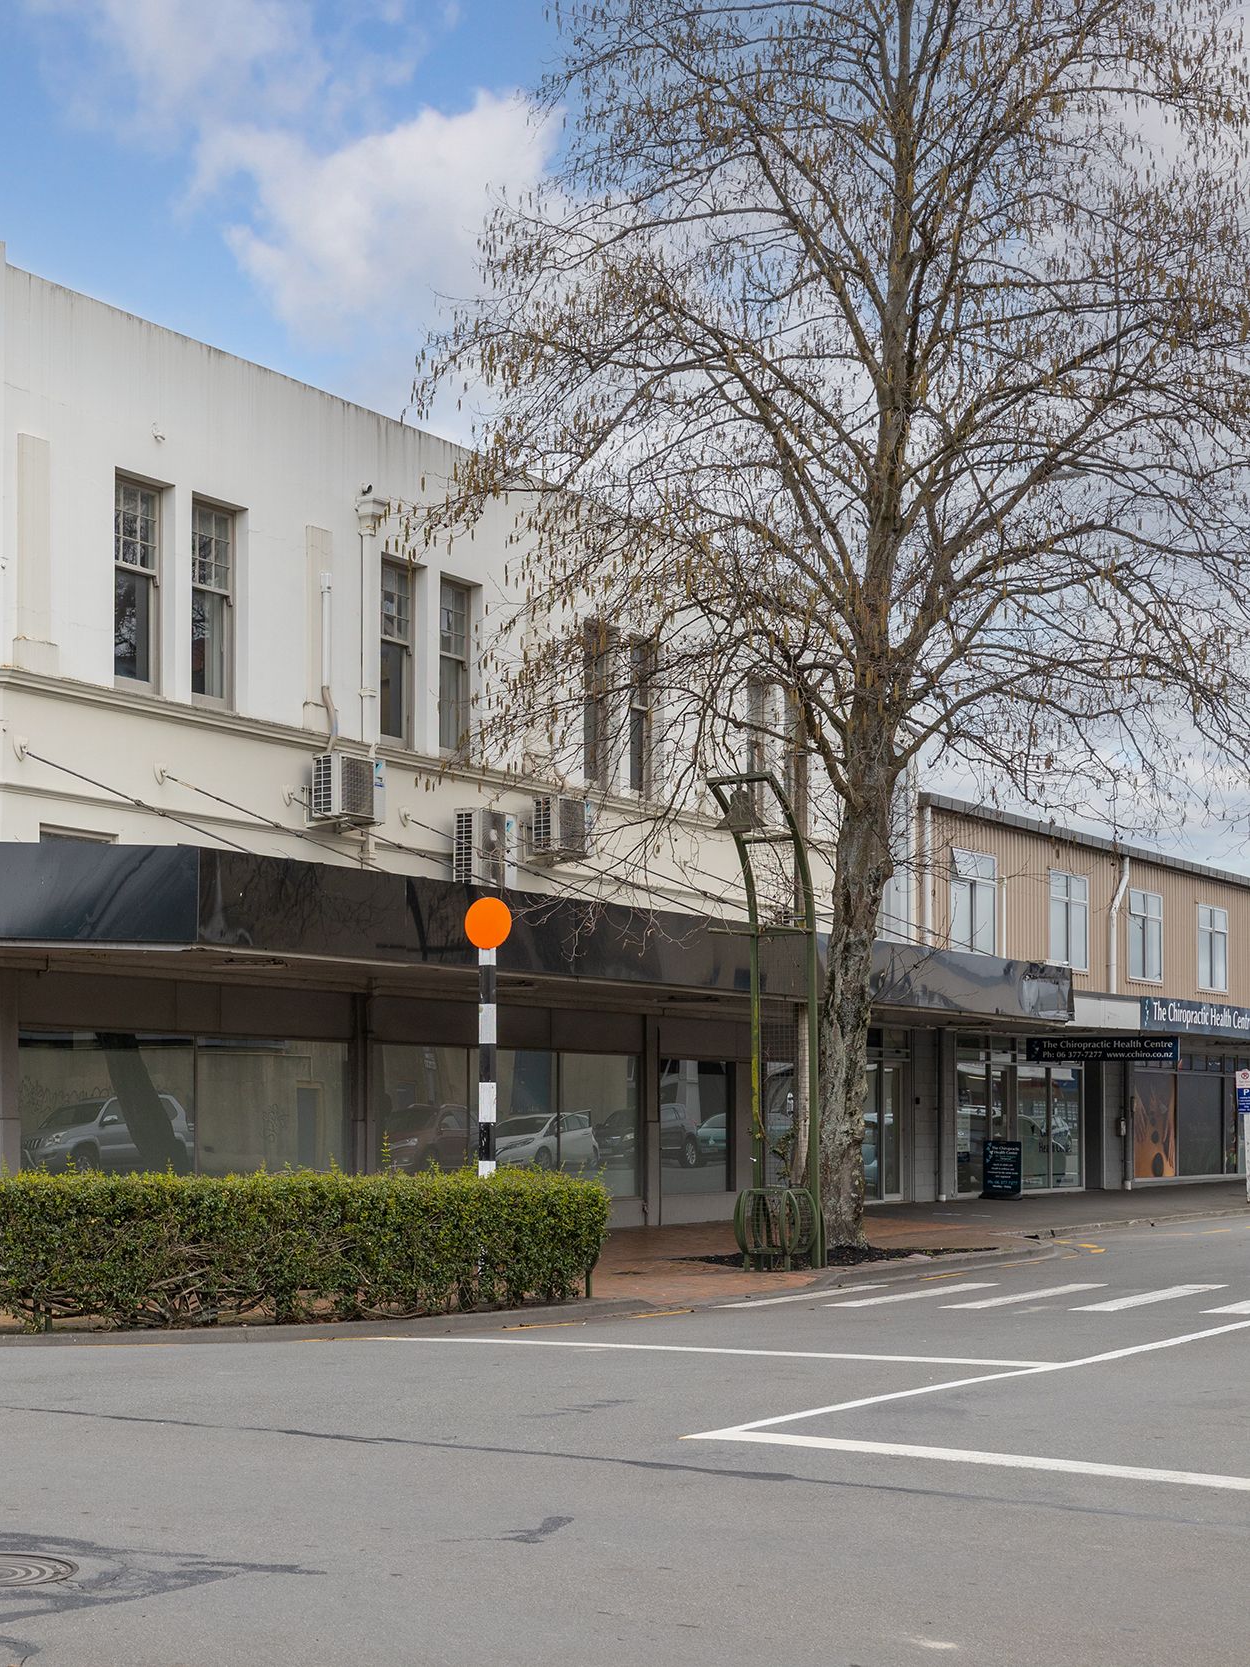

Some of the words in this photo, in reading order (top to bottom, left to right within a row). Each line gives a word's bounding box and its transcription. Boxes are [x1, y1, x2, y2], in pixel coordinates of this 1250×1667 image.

[1153, 1000, 1166, 1021] The
[1168, 1002, 1209, 1030] Chiropractic
[1210, 1007, 1231, 1028] Health
[1042, 1040, 1058, 1048] The
[1060, 1040, 1111, 1050] Chiropractic
[1113, 1040, 1141, 1048] Health
[1143, 1040, 1173, 1048] Centre
